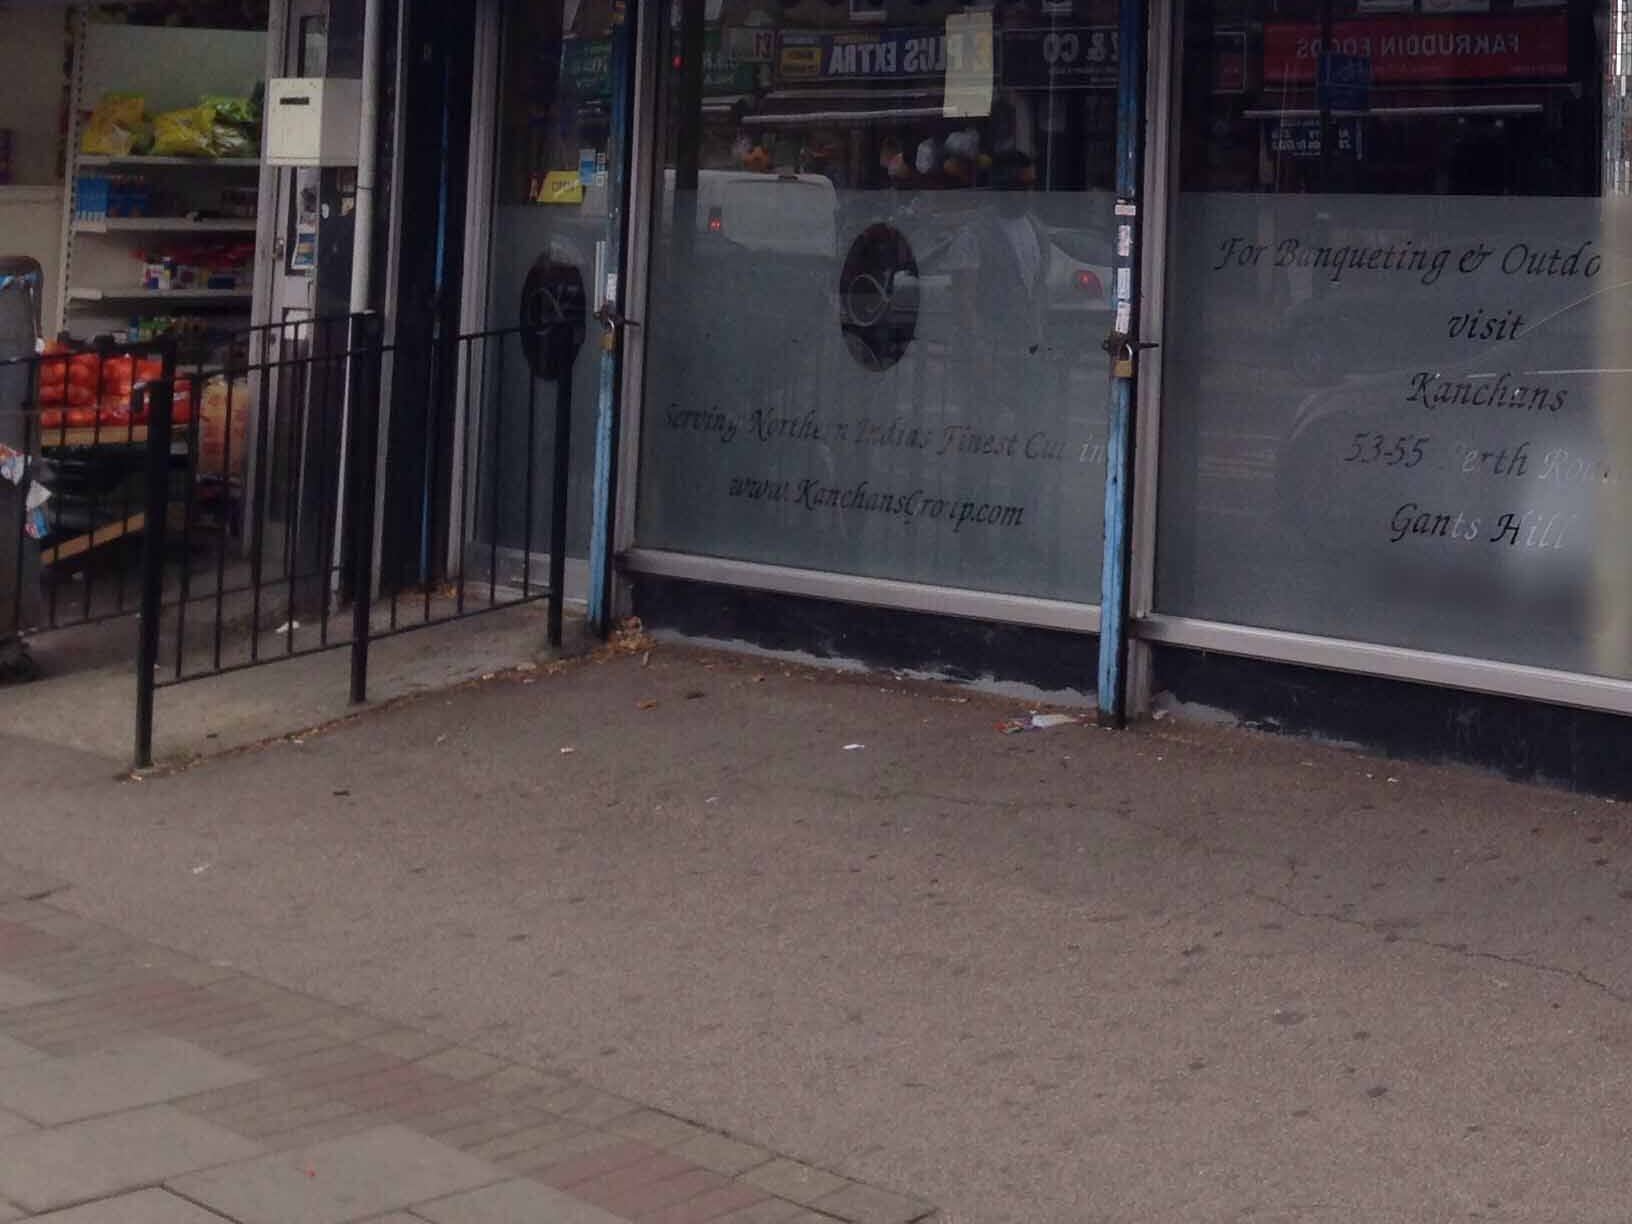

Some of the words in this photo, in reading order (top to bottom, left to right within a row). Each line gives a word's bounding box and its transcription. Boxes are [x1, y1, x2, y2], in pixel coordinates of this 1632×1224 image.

[1213, 237, 1264, 271] For
[1501, 241, 1618, 278] Outdo
[1447, 310, 1526, 342] visit
[1405, 371, 1568, 412] Kanchans
[747, 406, 850, 442] Northen
[1450, 440, 1530, 478] erth
[1390, 502, 1480, 544] Gants
[1489, 509, 1572, 549] Hill
